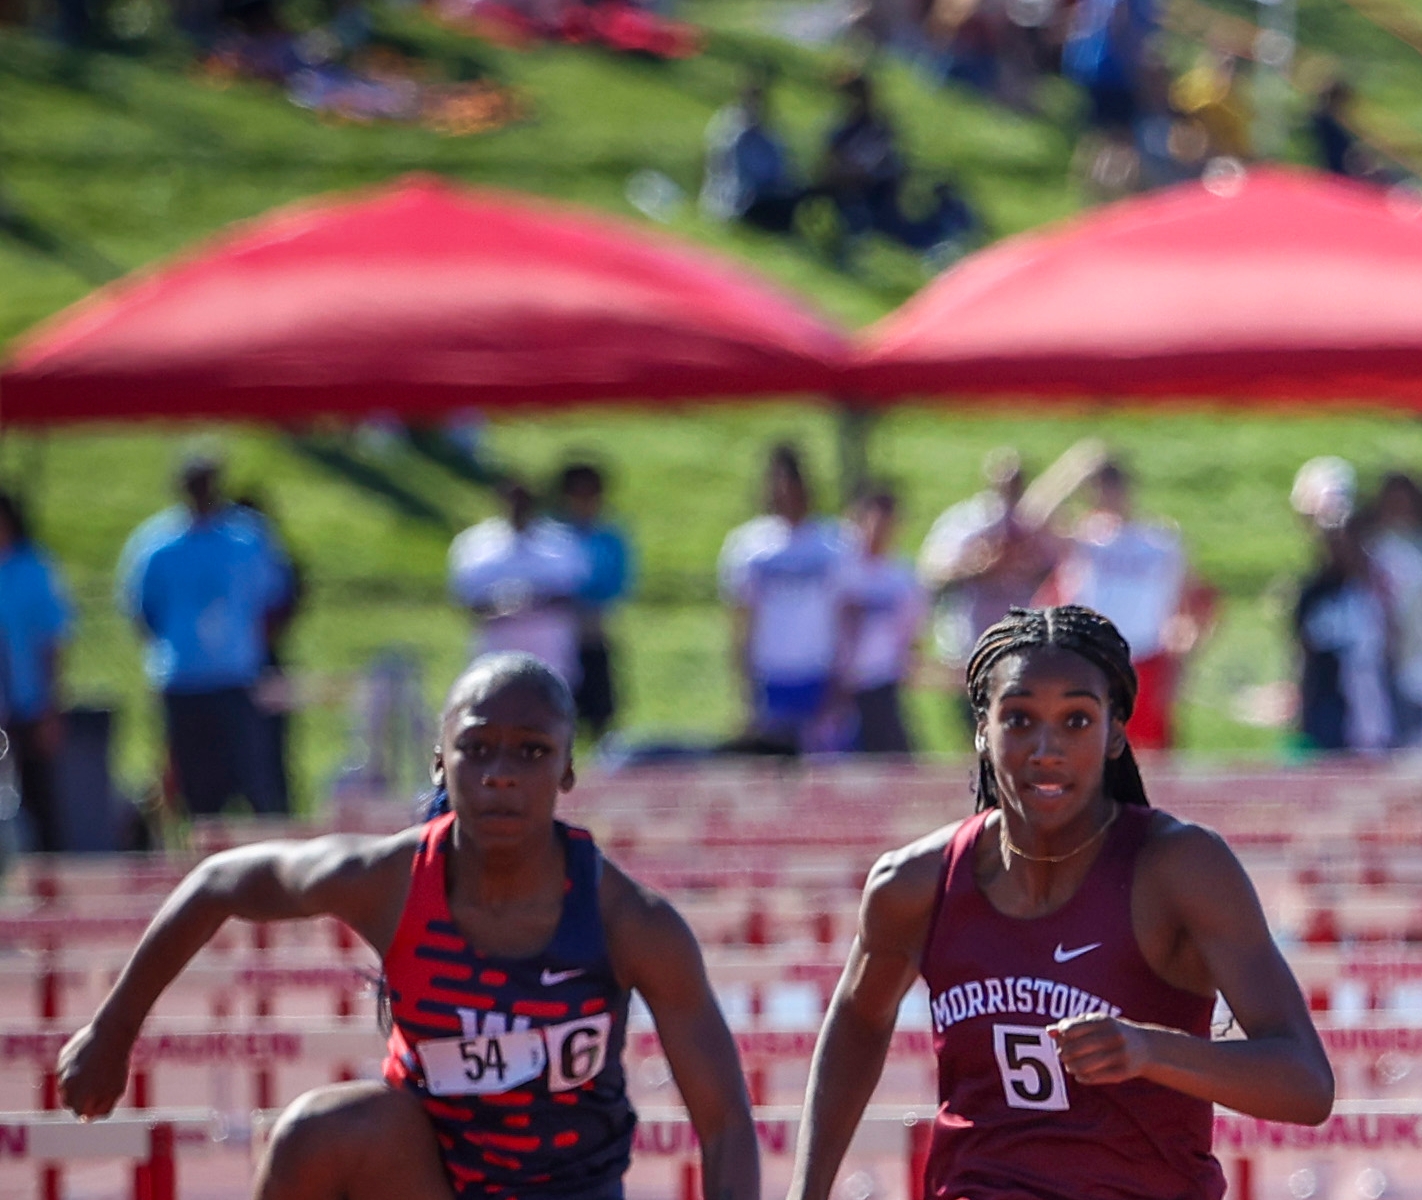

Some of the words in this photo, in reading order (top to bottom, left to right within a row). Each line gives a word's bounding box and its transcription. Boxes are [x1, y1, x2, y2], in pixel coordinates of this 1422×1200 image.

[459, 1039, 506, 1081] 54
[560, 1028, 599, 1078] 6
[1004, 1033, 1052, 1103] 5
